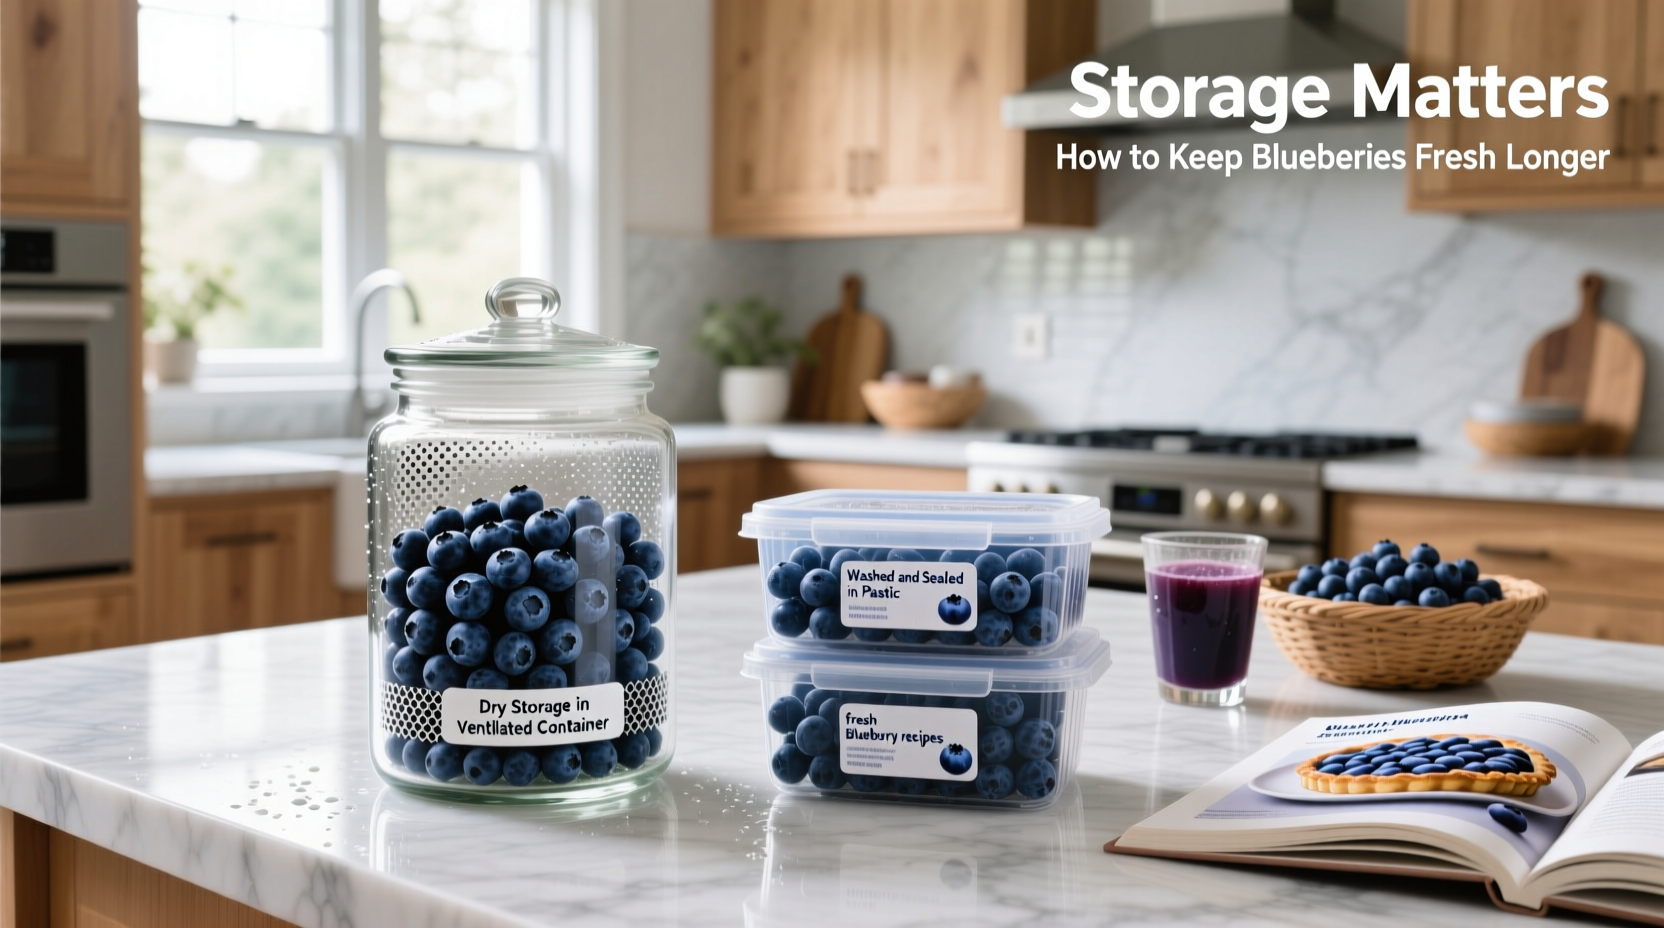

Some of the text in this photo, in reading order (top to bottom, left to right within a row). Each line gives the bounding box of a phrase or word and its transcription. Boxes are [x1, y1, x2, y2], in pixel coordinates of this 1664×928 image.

[846, 569, 964, 585] Washed and Sealed
[847, 585, 901, 598] in Pastic
[479, 696, 590, 718] Dry Storage in
[537, 717, 610, 735] Container
[845, 712, 878, 726] fresh
